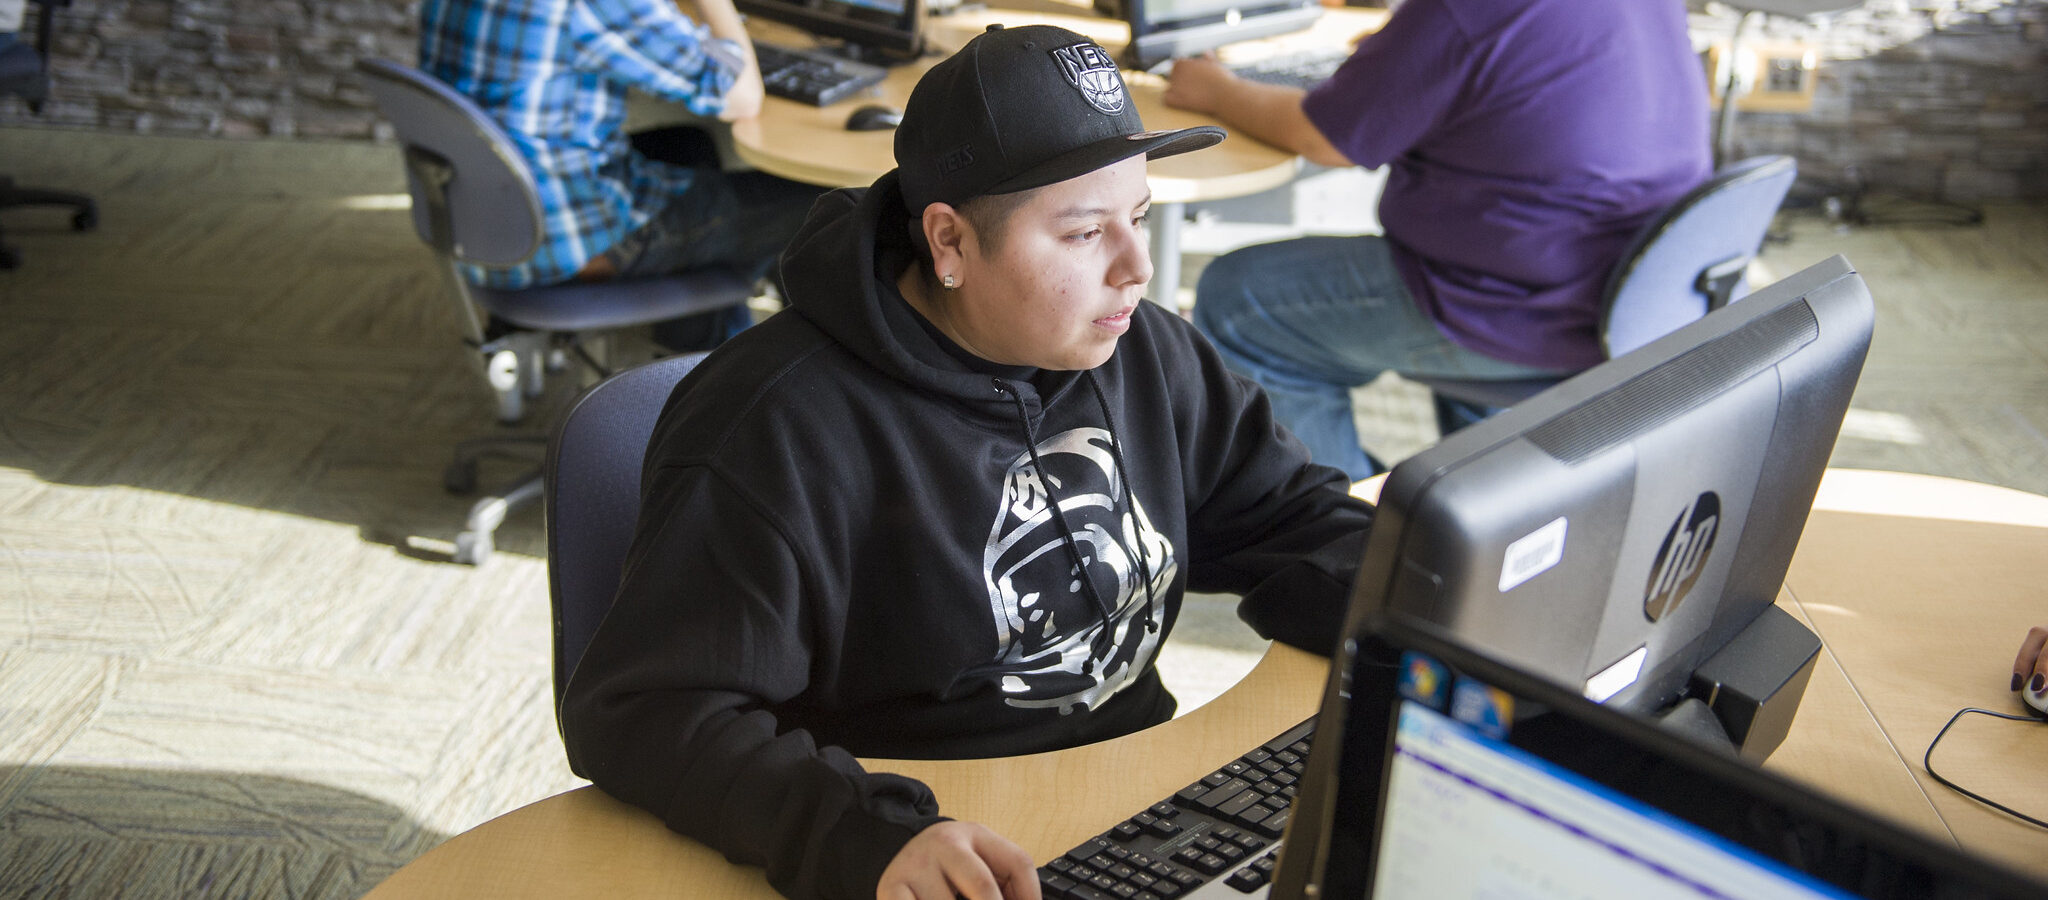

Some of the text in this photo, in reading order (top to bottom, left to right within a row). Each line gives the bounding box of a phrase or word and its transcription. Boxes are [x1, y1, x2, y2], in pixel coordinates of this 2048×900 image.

[1053, 42, 1115, 86] NETS
[935, 143, 976, 177] NETS
[1649, 493, 1719, 622] hp
